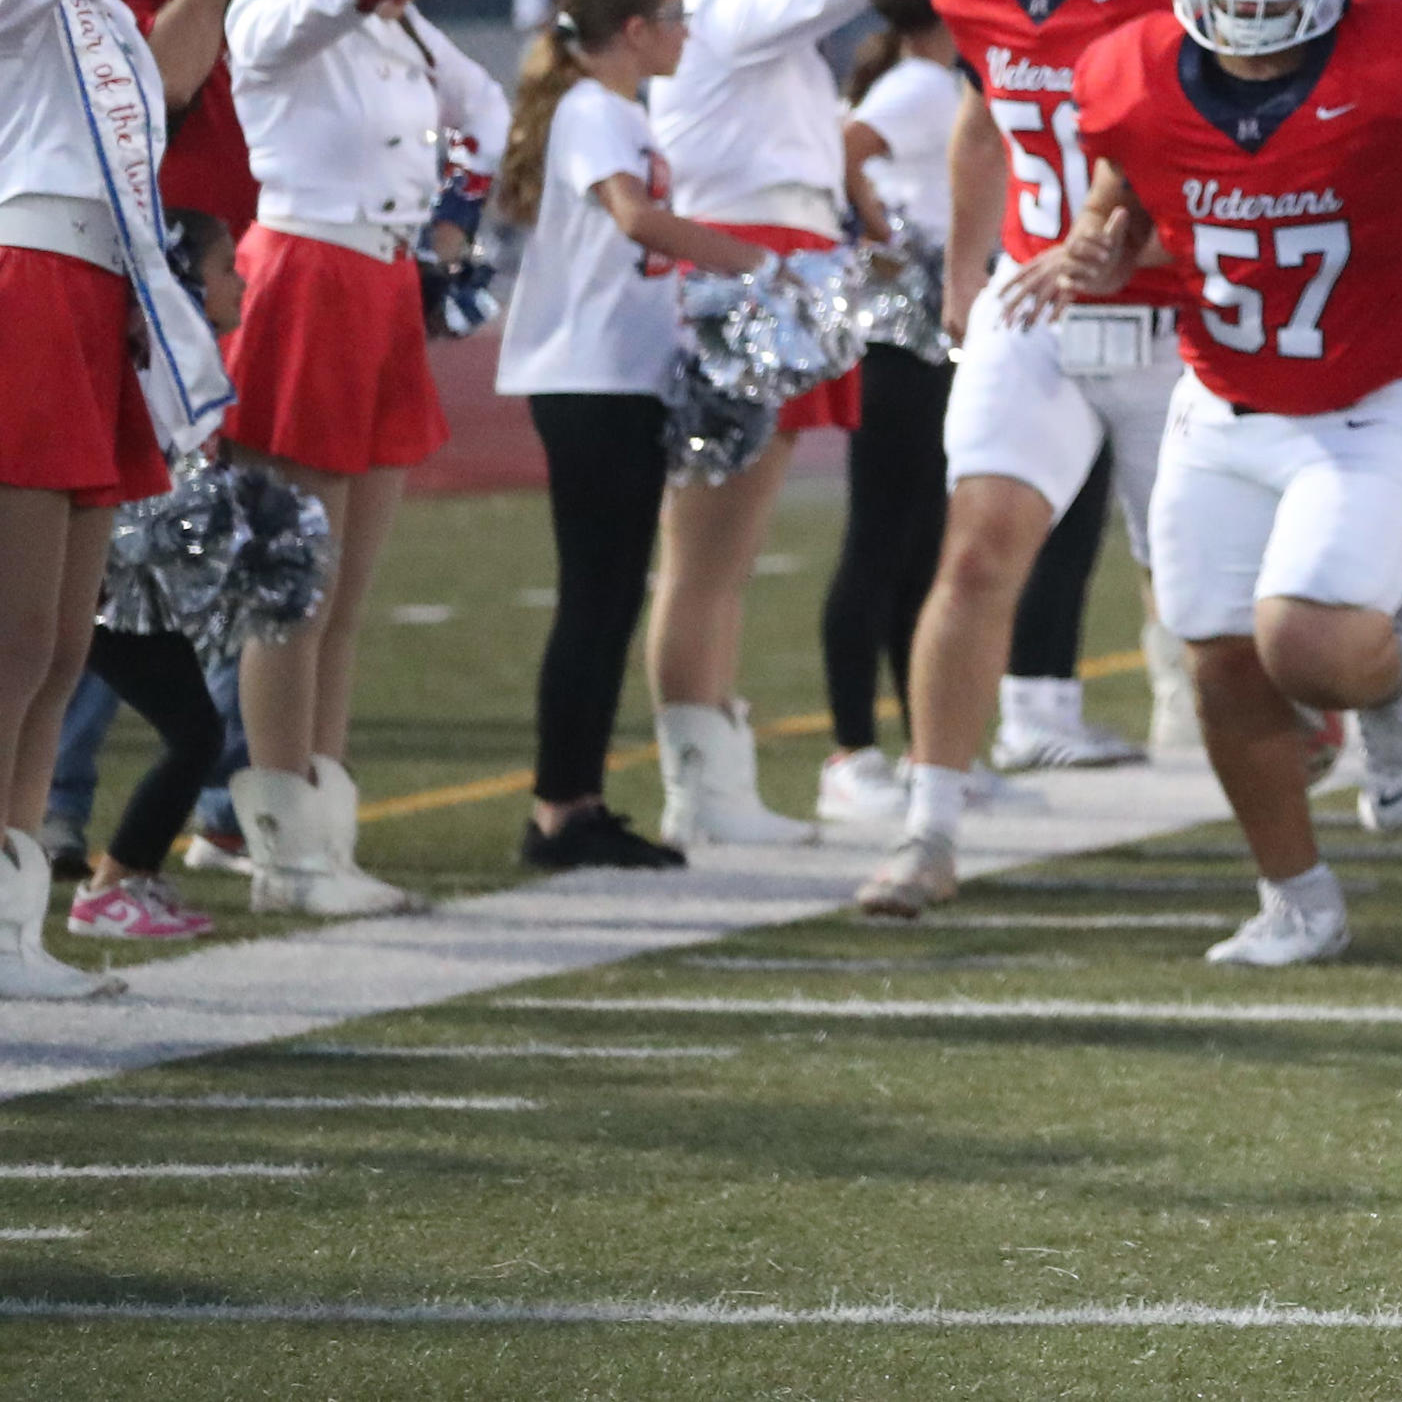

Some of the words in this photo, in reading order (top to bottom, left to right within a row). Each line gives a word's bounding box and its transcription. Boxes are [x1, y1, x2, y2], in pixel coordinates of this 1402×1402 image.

[986, 45, 1073, 91] Vetera
[107, 102, 138, 146] the
[1183, 178, 1343, 219] Veterans
[1192, 219, 1352, 361] 57
